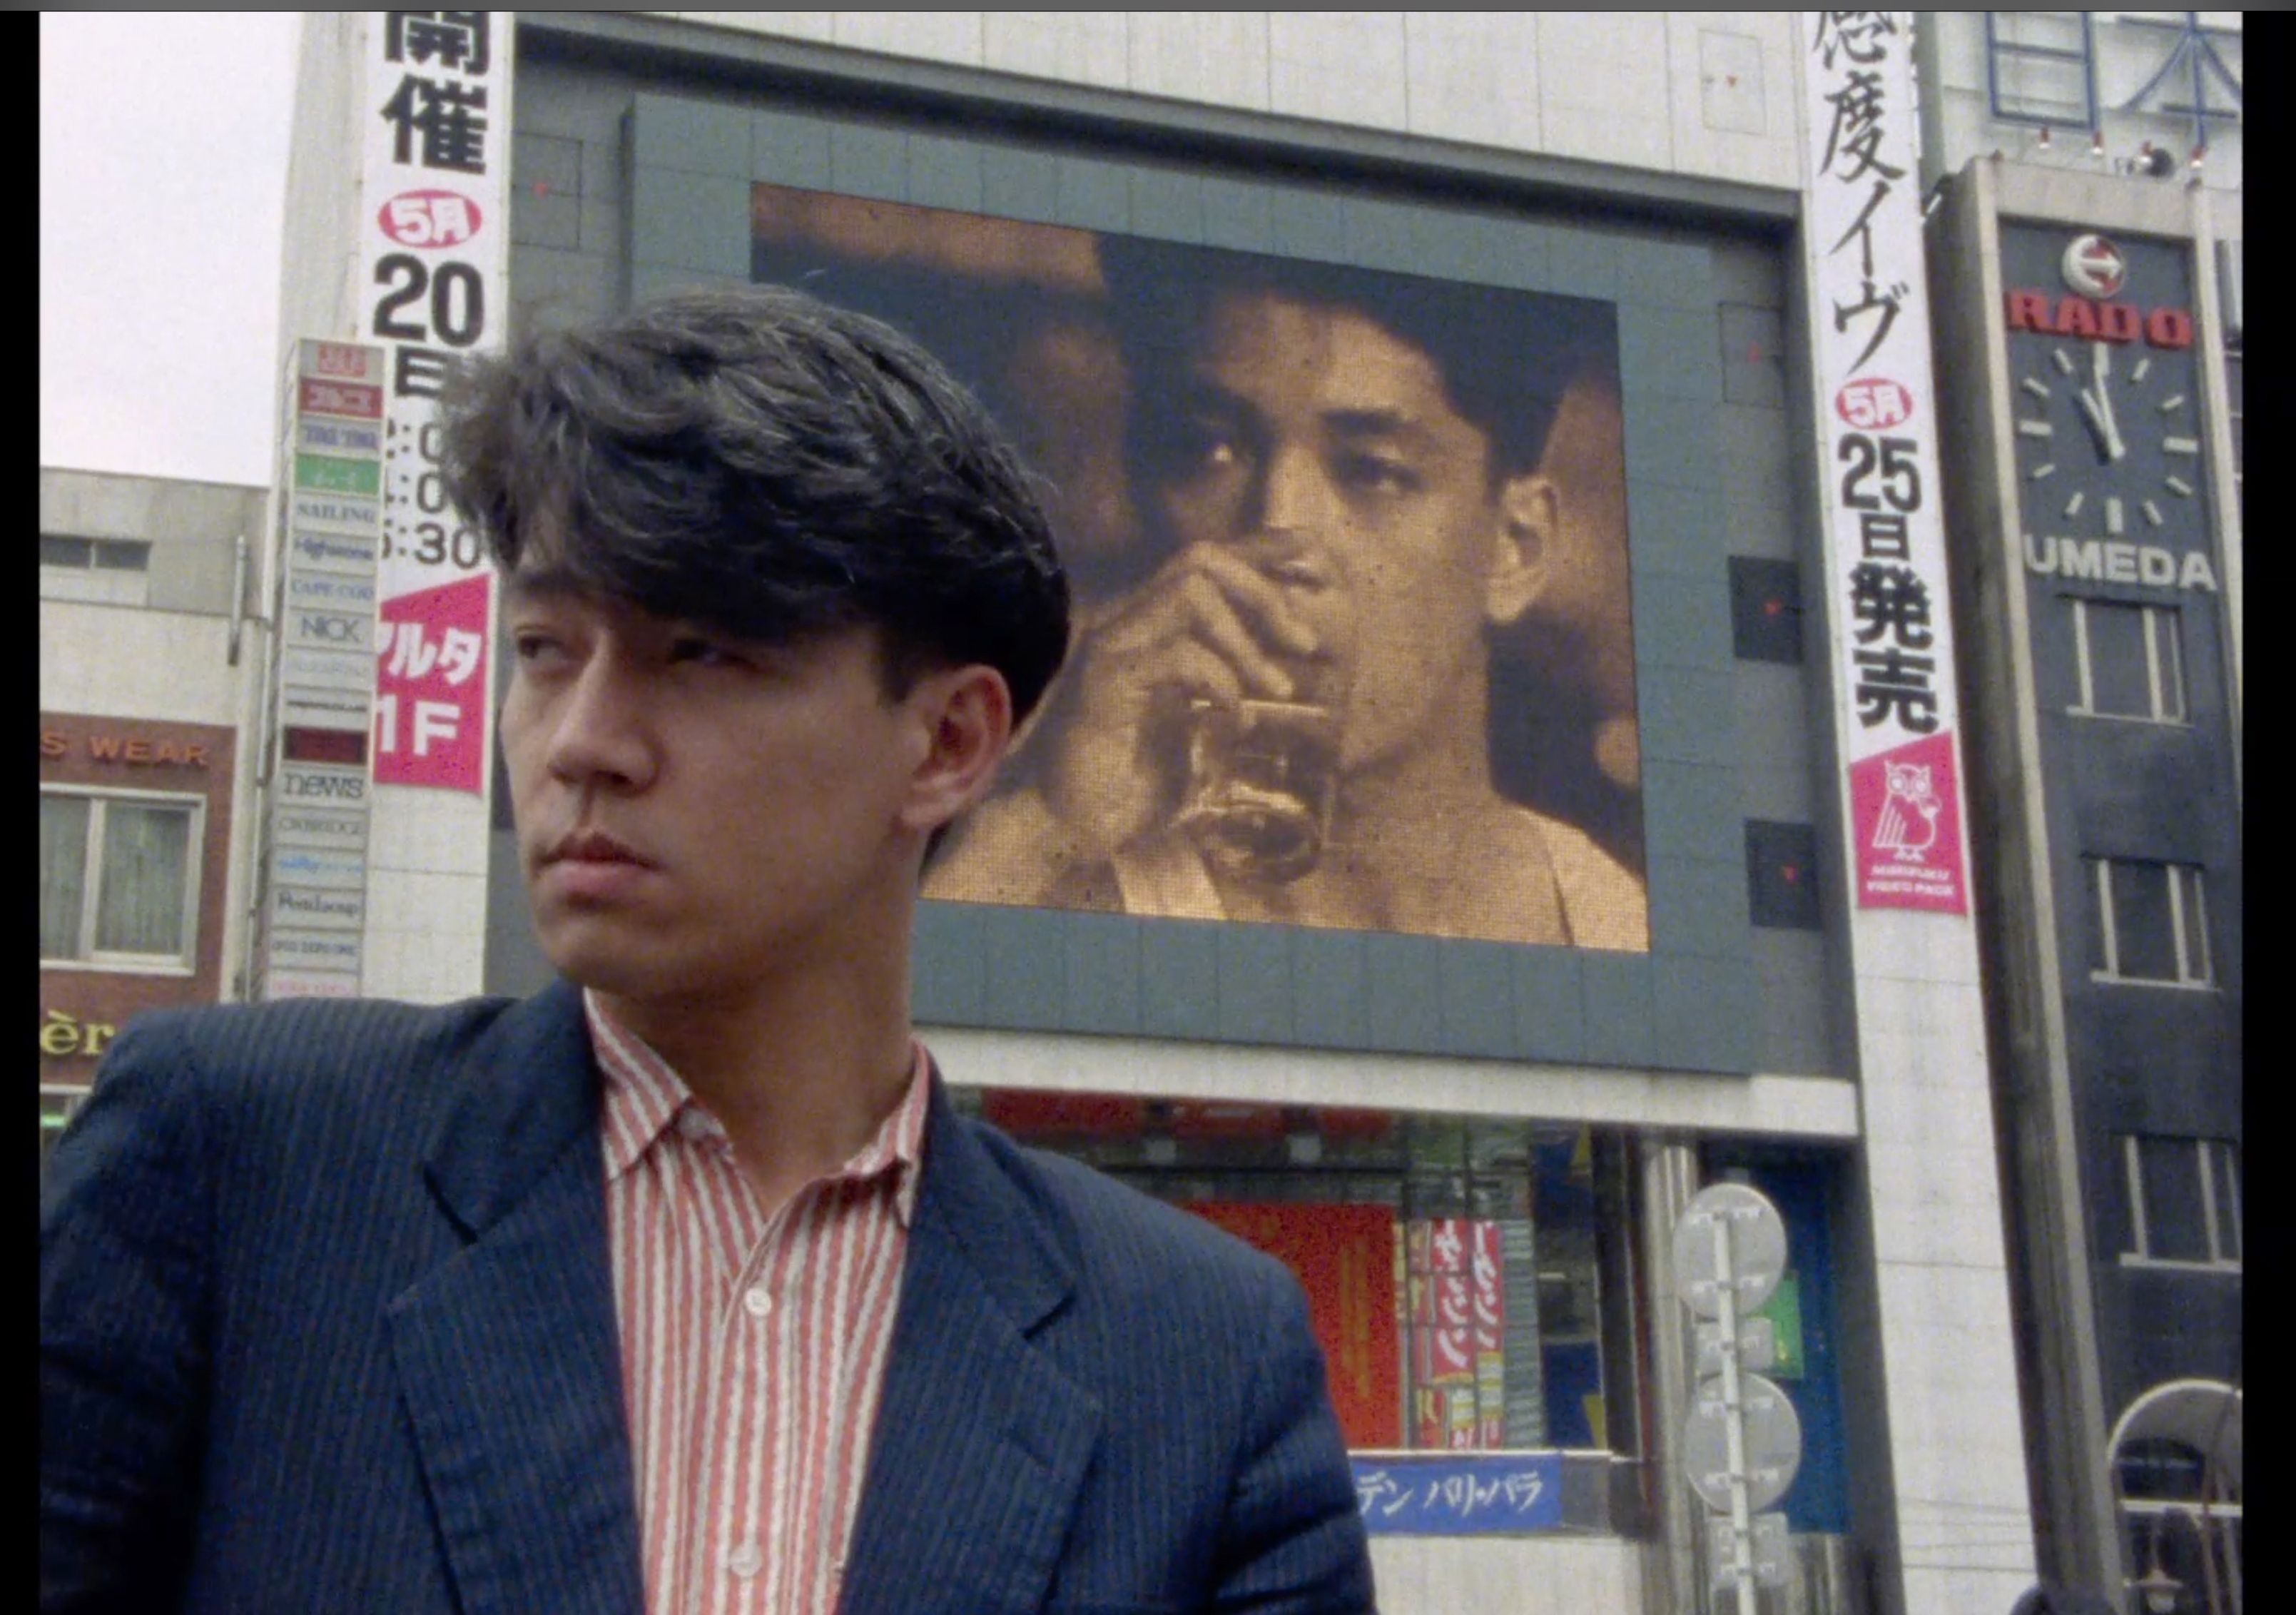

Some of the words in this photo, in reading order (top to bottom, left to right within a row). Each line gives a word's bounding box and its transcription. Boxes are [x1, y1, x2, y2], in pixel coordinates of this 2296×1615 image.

[389, 198, 472, 244] 5月
[2009, 289, 2193, 348] RADO
[1842, 385, 1905, 427] 5月
[2023, 534, 2217, 591] UMEDA
[377, 622, 482, 686] ルタ
[377, 694, 460, 757] 1F
[90, 736, 209, 768] WEAR
[285, 773, 365, 799] news
